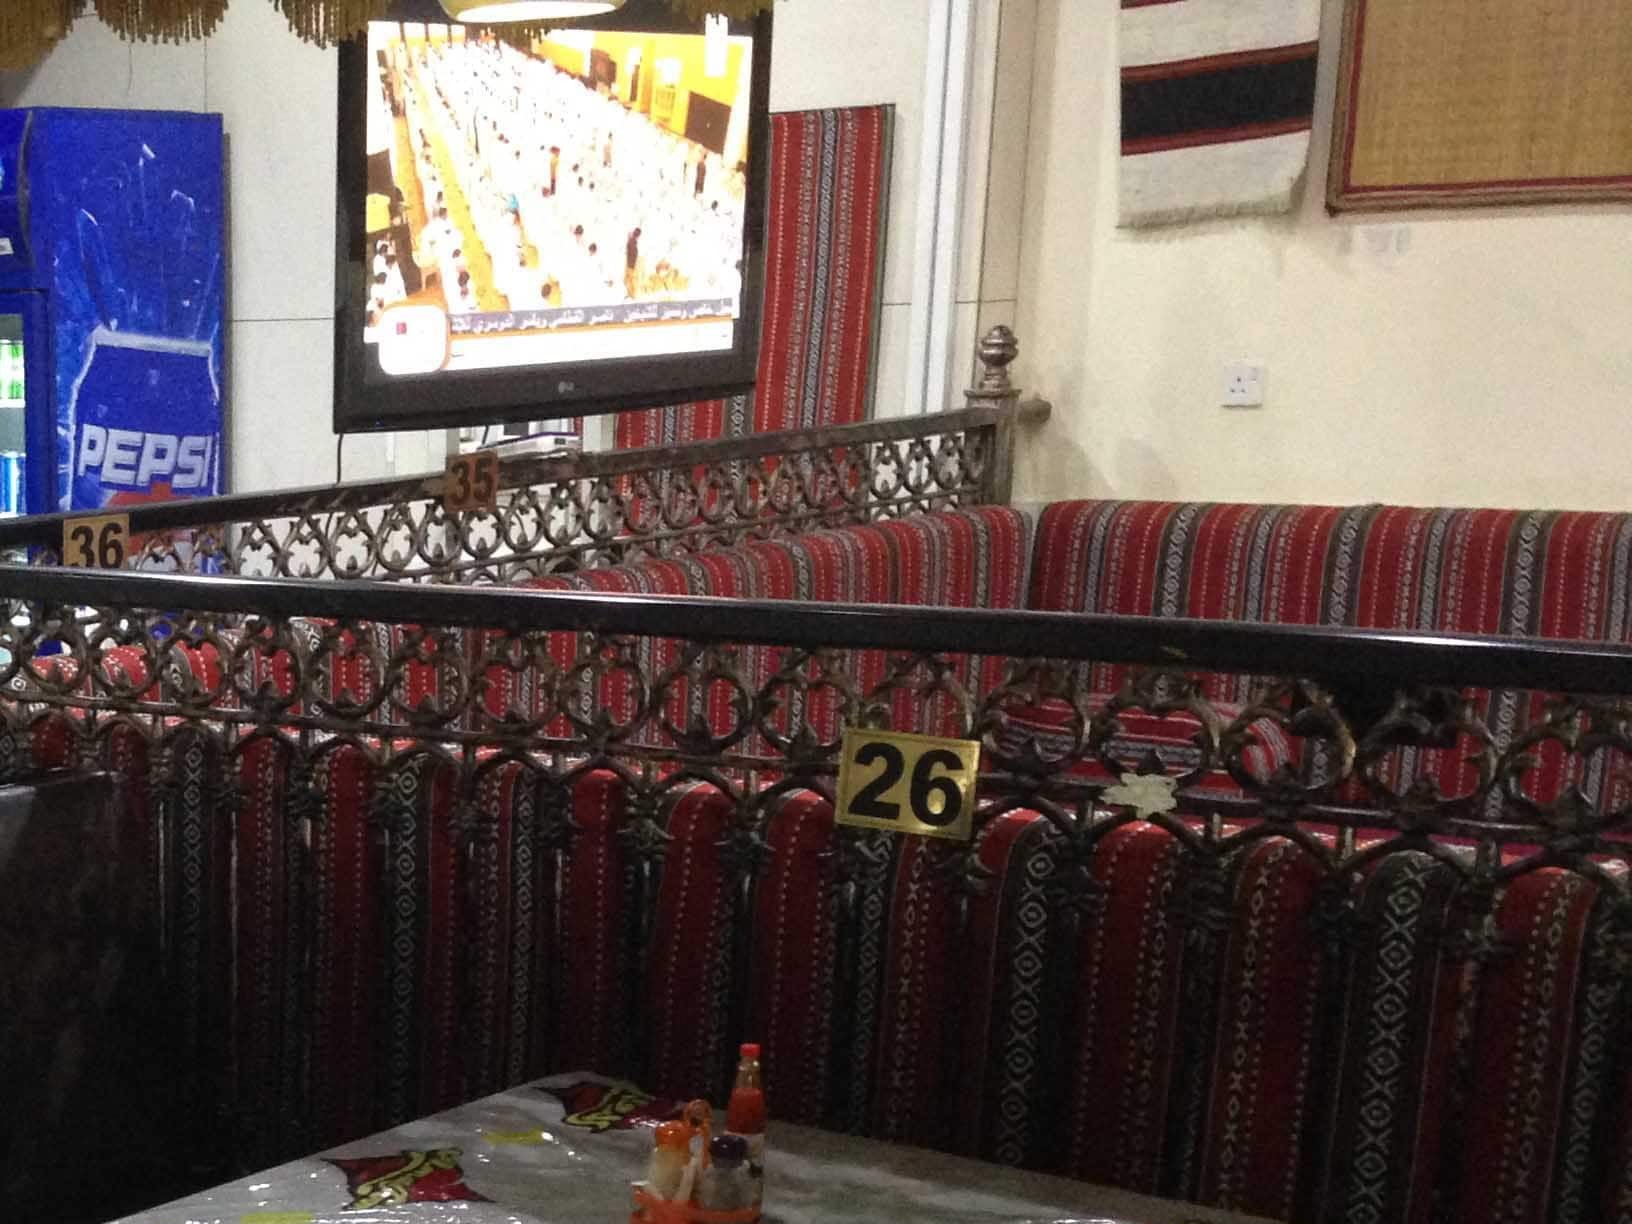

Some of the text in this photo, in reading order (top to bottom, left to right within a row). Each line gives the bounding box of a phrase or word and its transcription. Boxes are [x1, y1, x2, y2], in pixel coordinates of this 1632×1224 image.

[77, 423, 213, 489] PEPSI
[451, 458, 494, 505] 35
[70, 522, 124, 569] 36
[848, 741, 965, 827] 26
